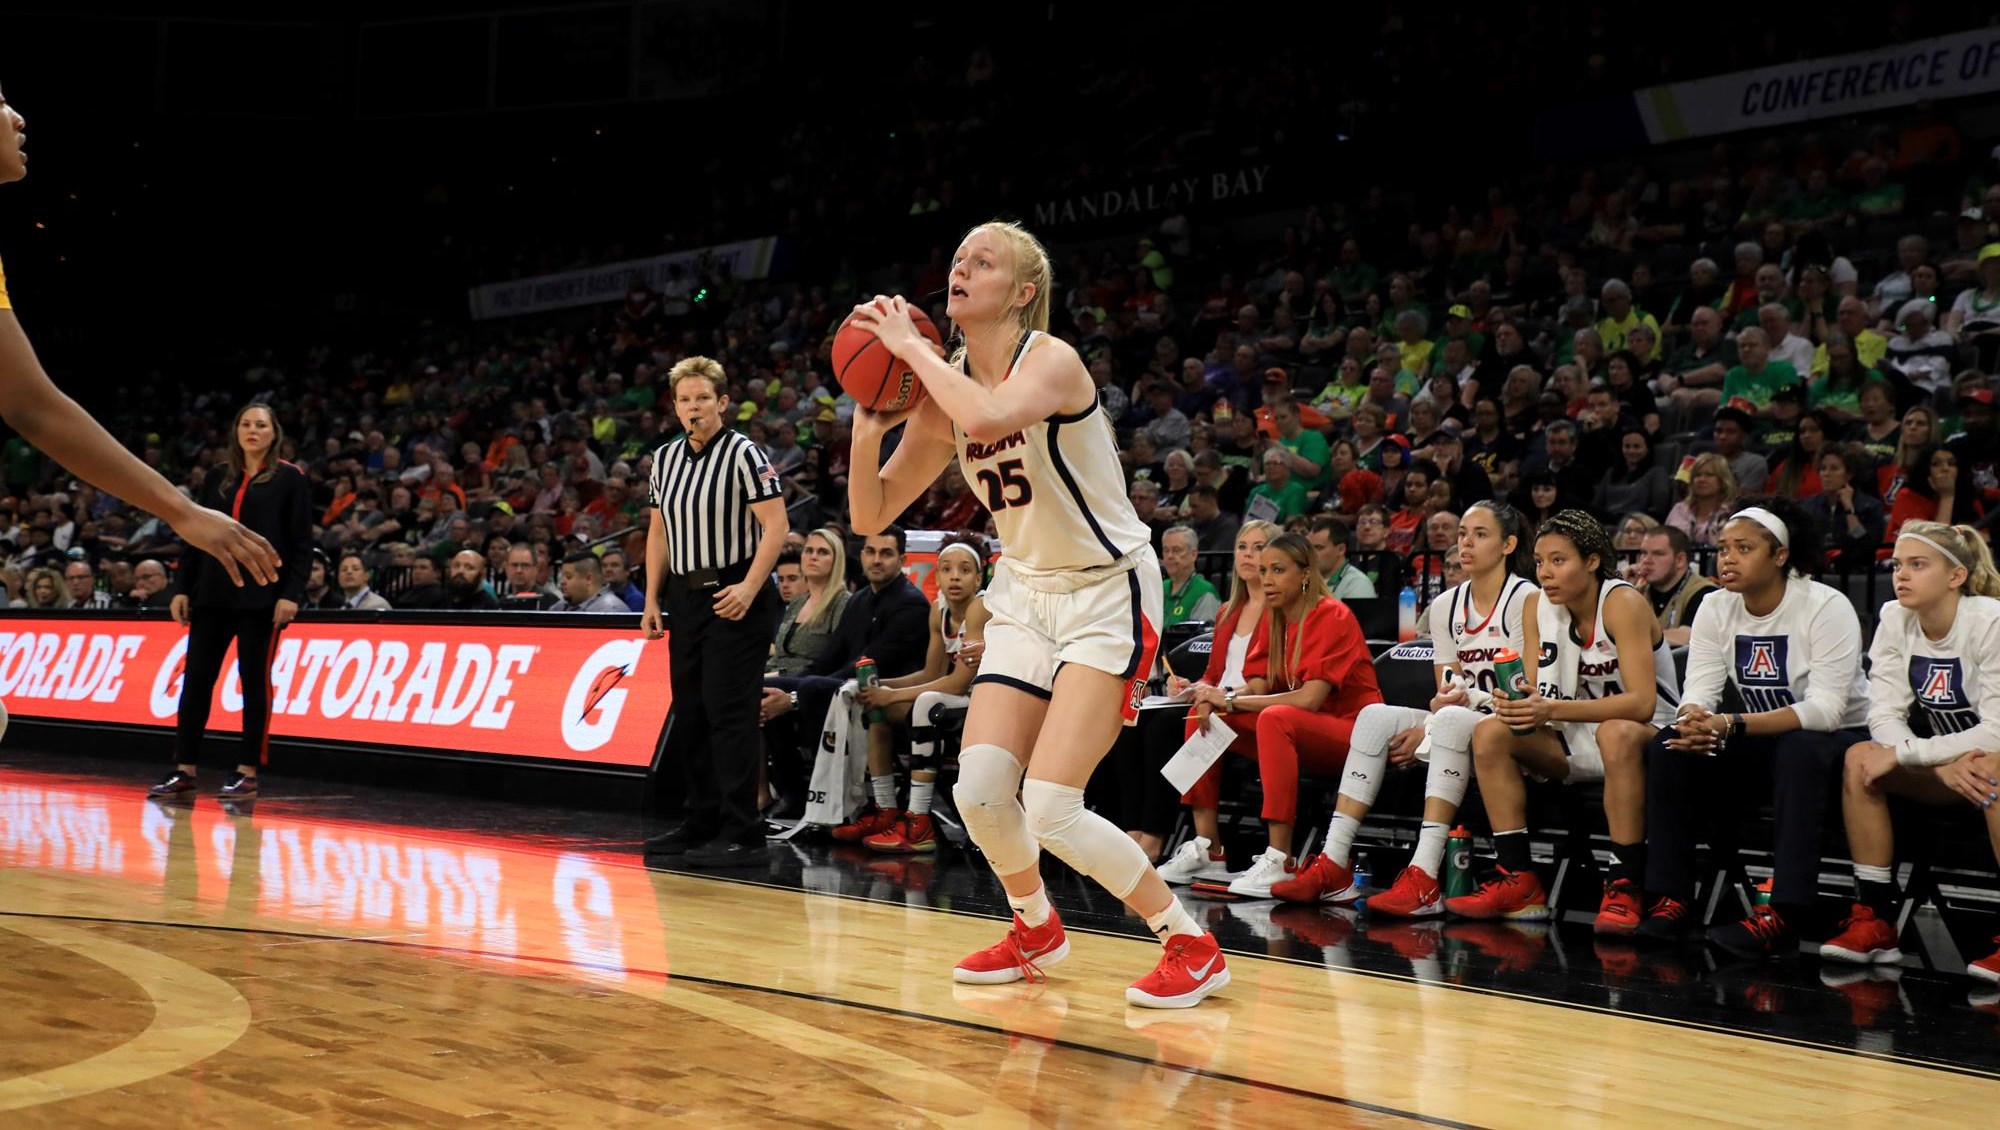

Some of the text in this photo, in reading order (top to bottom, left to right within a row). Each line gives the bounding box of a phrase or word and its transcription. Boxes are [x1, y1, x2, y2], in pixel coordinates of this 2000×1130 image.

[1742, 41, 2000, 116] CONFERENCE OF
[1211, 164, 1271, 201] BAY
[976, 458, 1033, 512] 25
[560, 638, 649, 752] G
